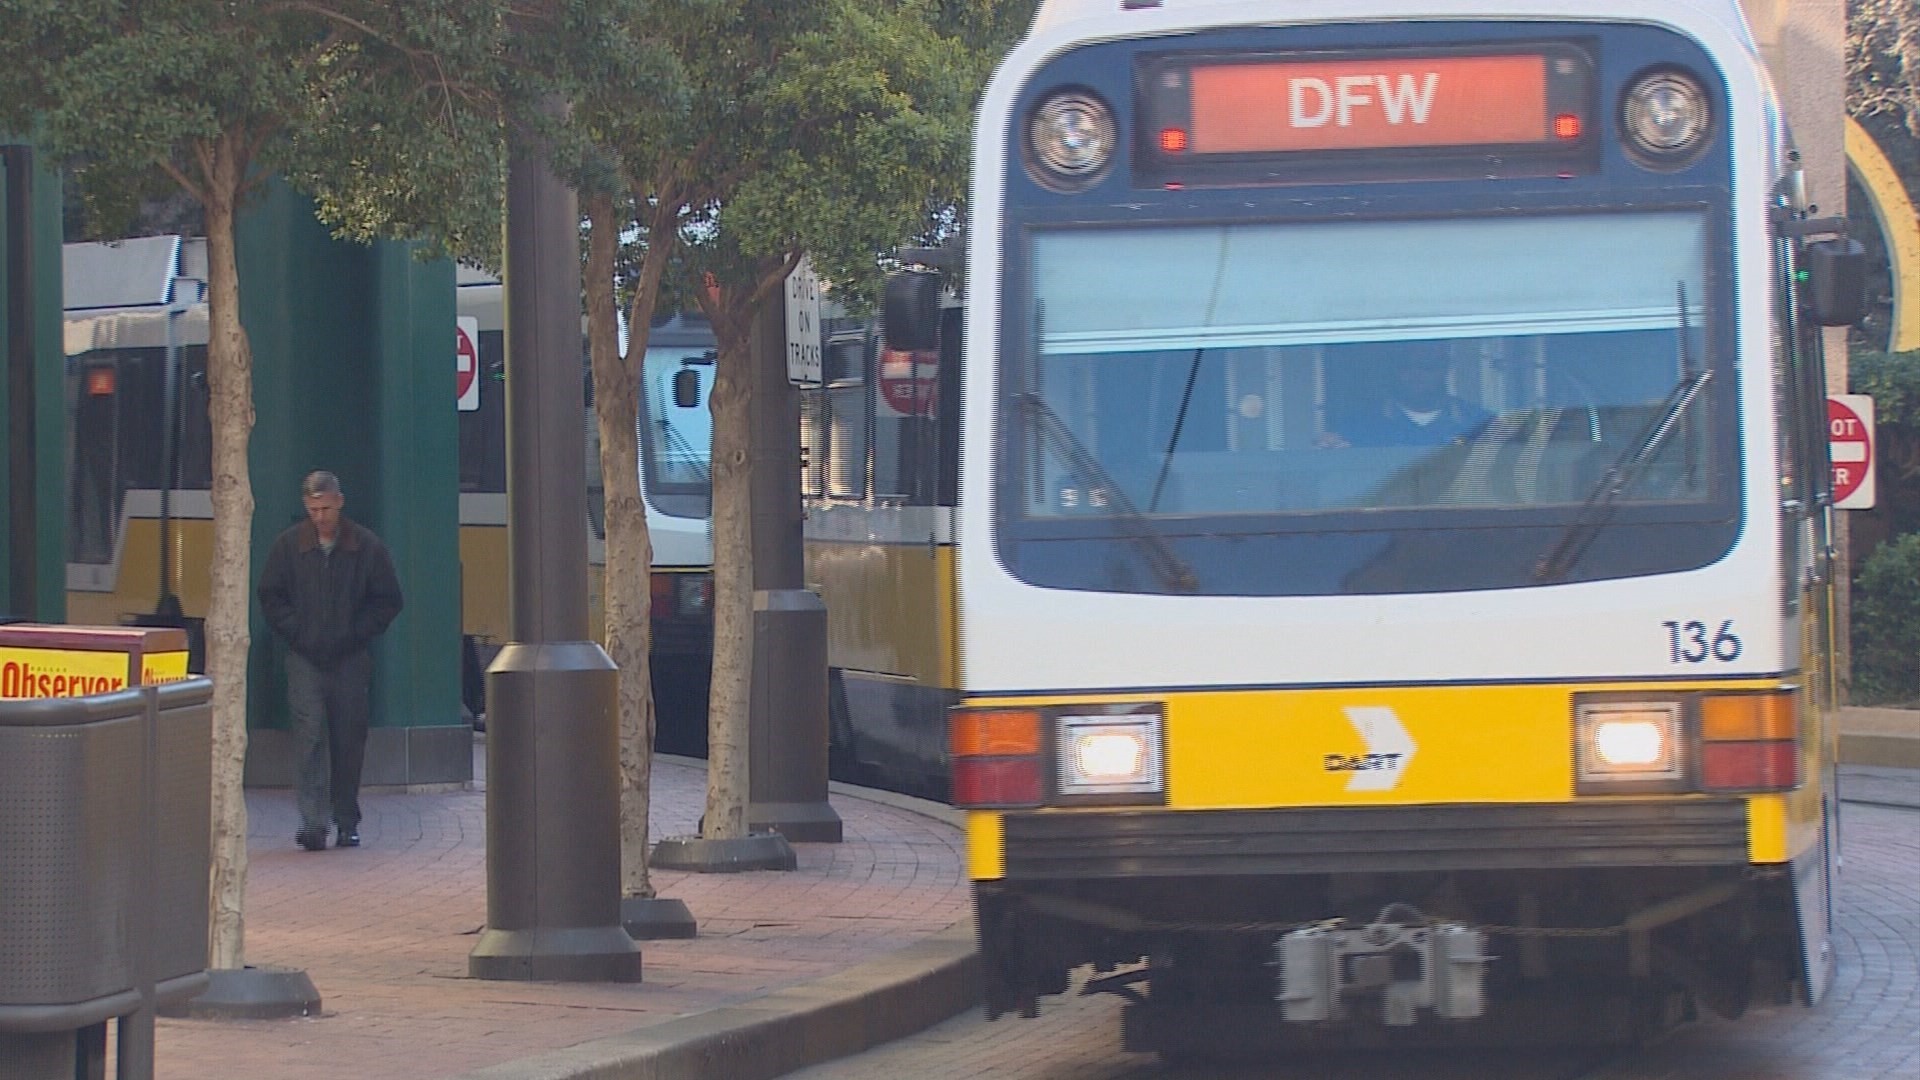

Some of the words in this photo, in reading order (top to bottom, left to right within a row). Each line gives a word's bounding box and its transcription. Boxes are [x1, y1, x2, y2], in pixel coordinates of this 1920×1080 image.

[1288, 73, 1440, 128] DFW
[798, 310, 811, 333] ON
[790, 342, 820, 367] TRACKS
[1830, 418, 1857, 436] OT
[1661, 619, 1743, 663] 136
[1323, 753, 1403, 771] DART
